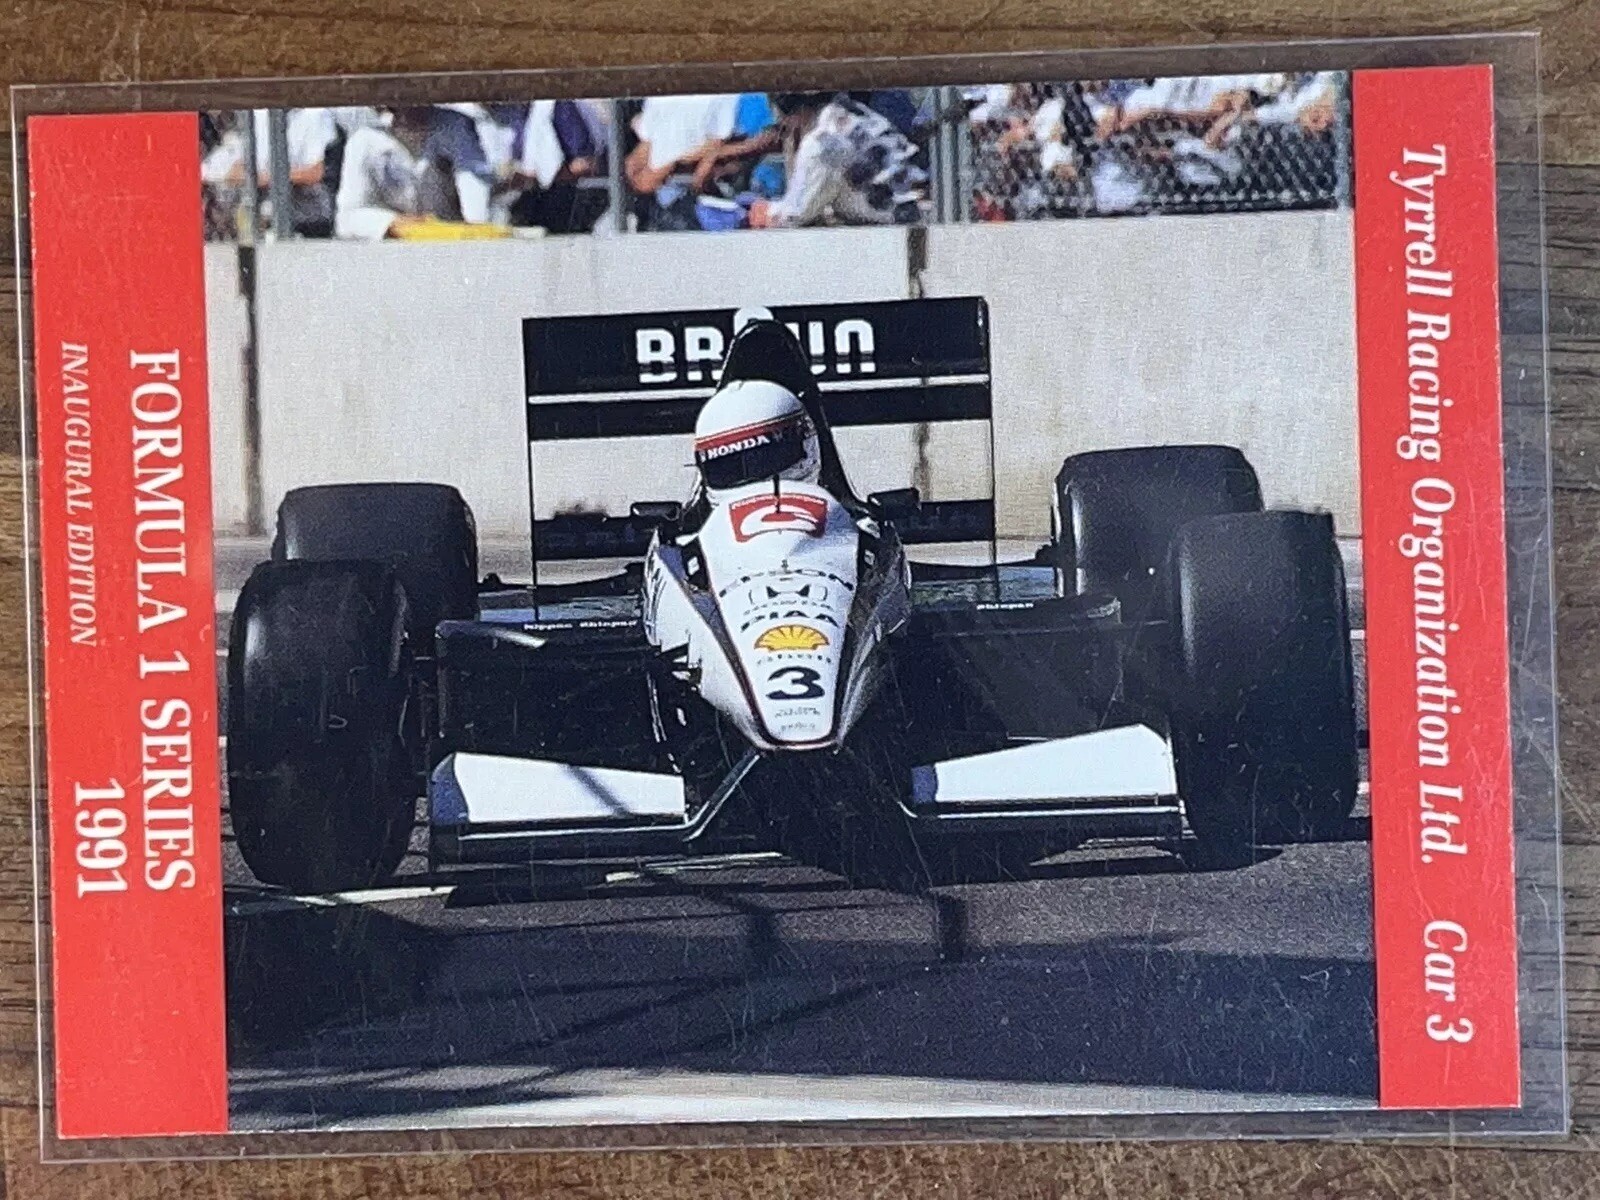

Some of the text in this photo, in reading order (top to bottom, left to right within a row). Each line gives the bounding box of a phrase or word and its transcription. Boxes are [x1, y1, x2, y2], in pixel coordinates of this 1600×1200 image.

[635, 306, 876, 384] BRUN
[61, 341, 97, 647] INAUGURAL EDITION
[707, 434, 771, 460] HONDA
[130, 349, 196, 891] FORMULA 1 SERIES
[1389, 144, 1474, 1043] Tyrrell Racing Organization Ltd. Car 3
[766, 666, 825, 699] 3
[75, 778, 128, 898] 1991
